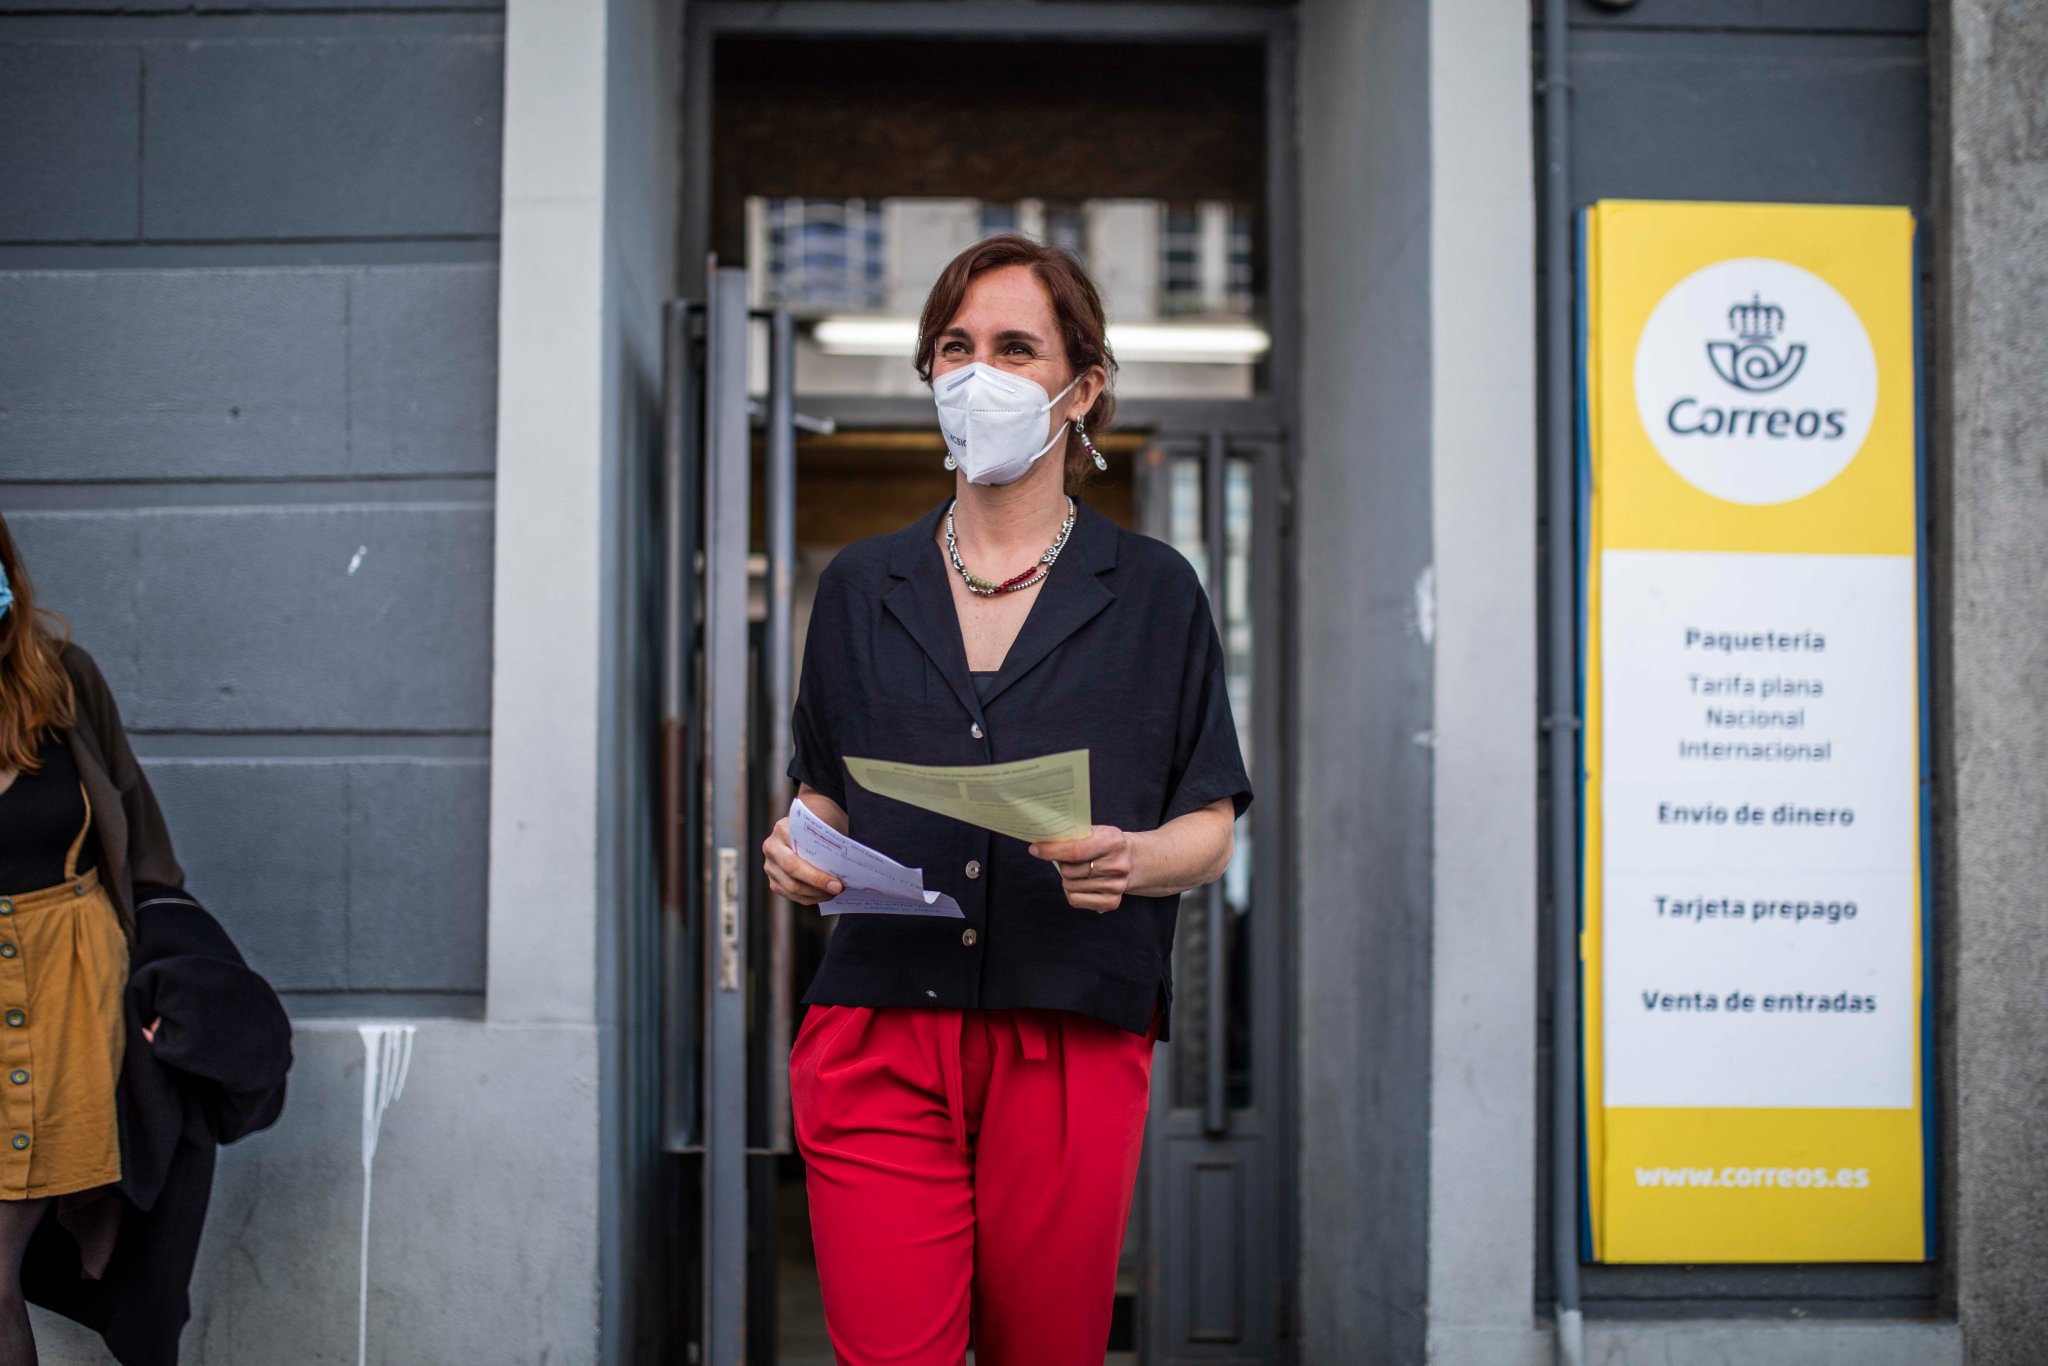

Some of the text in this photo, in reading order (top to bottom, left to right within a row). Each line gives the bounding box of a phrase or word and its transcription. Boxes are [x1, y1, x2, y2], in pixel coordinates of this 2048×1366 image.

[1667, 397, 1847, 440] Correos
[1686, 627, 1826, 653] Paquetería
[1689, 674, 1824, 700] Tarifa plana
[1706, 708, 1805, 728] Nacional
[1679, 740, 1832, 761] Internacional
[1657, 802, 1855, 827] Envío de dinero
[1654, 896, 1859, 925] Tarjeta prepago
[1641, 990, 1878, 1014] Venta de entradas
[1634, 1166, 1871, 1189] www.correos.es
